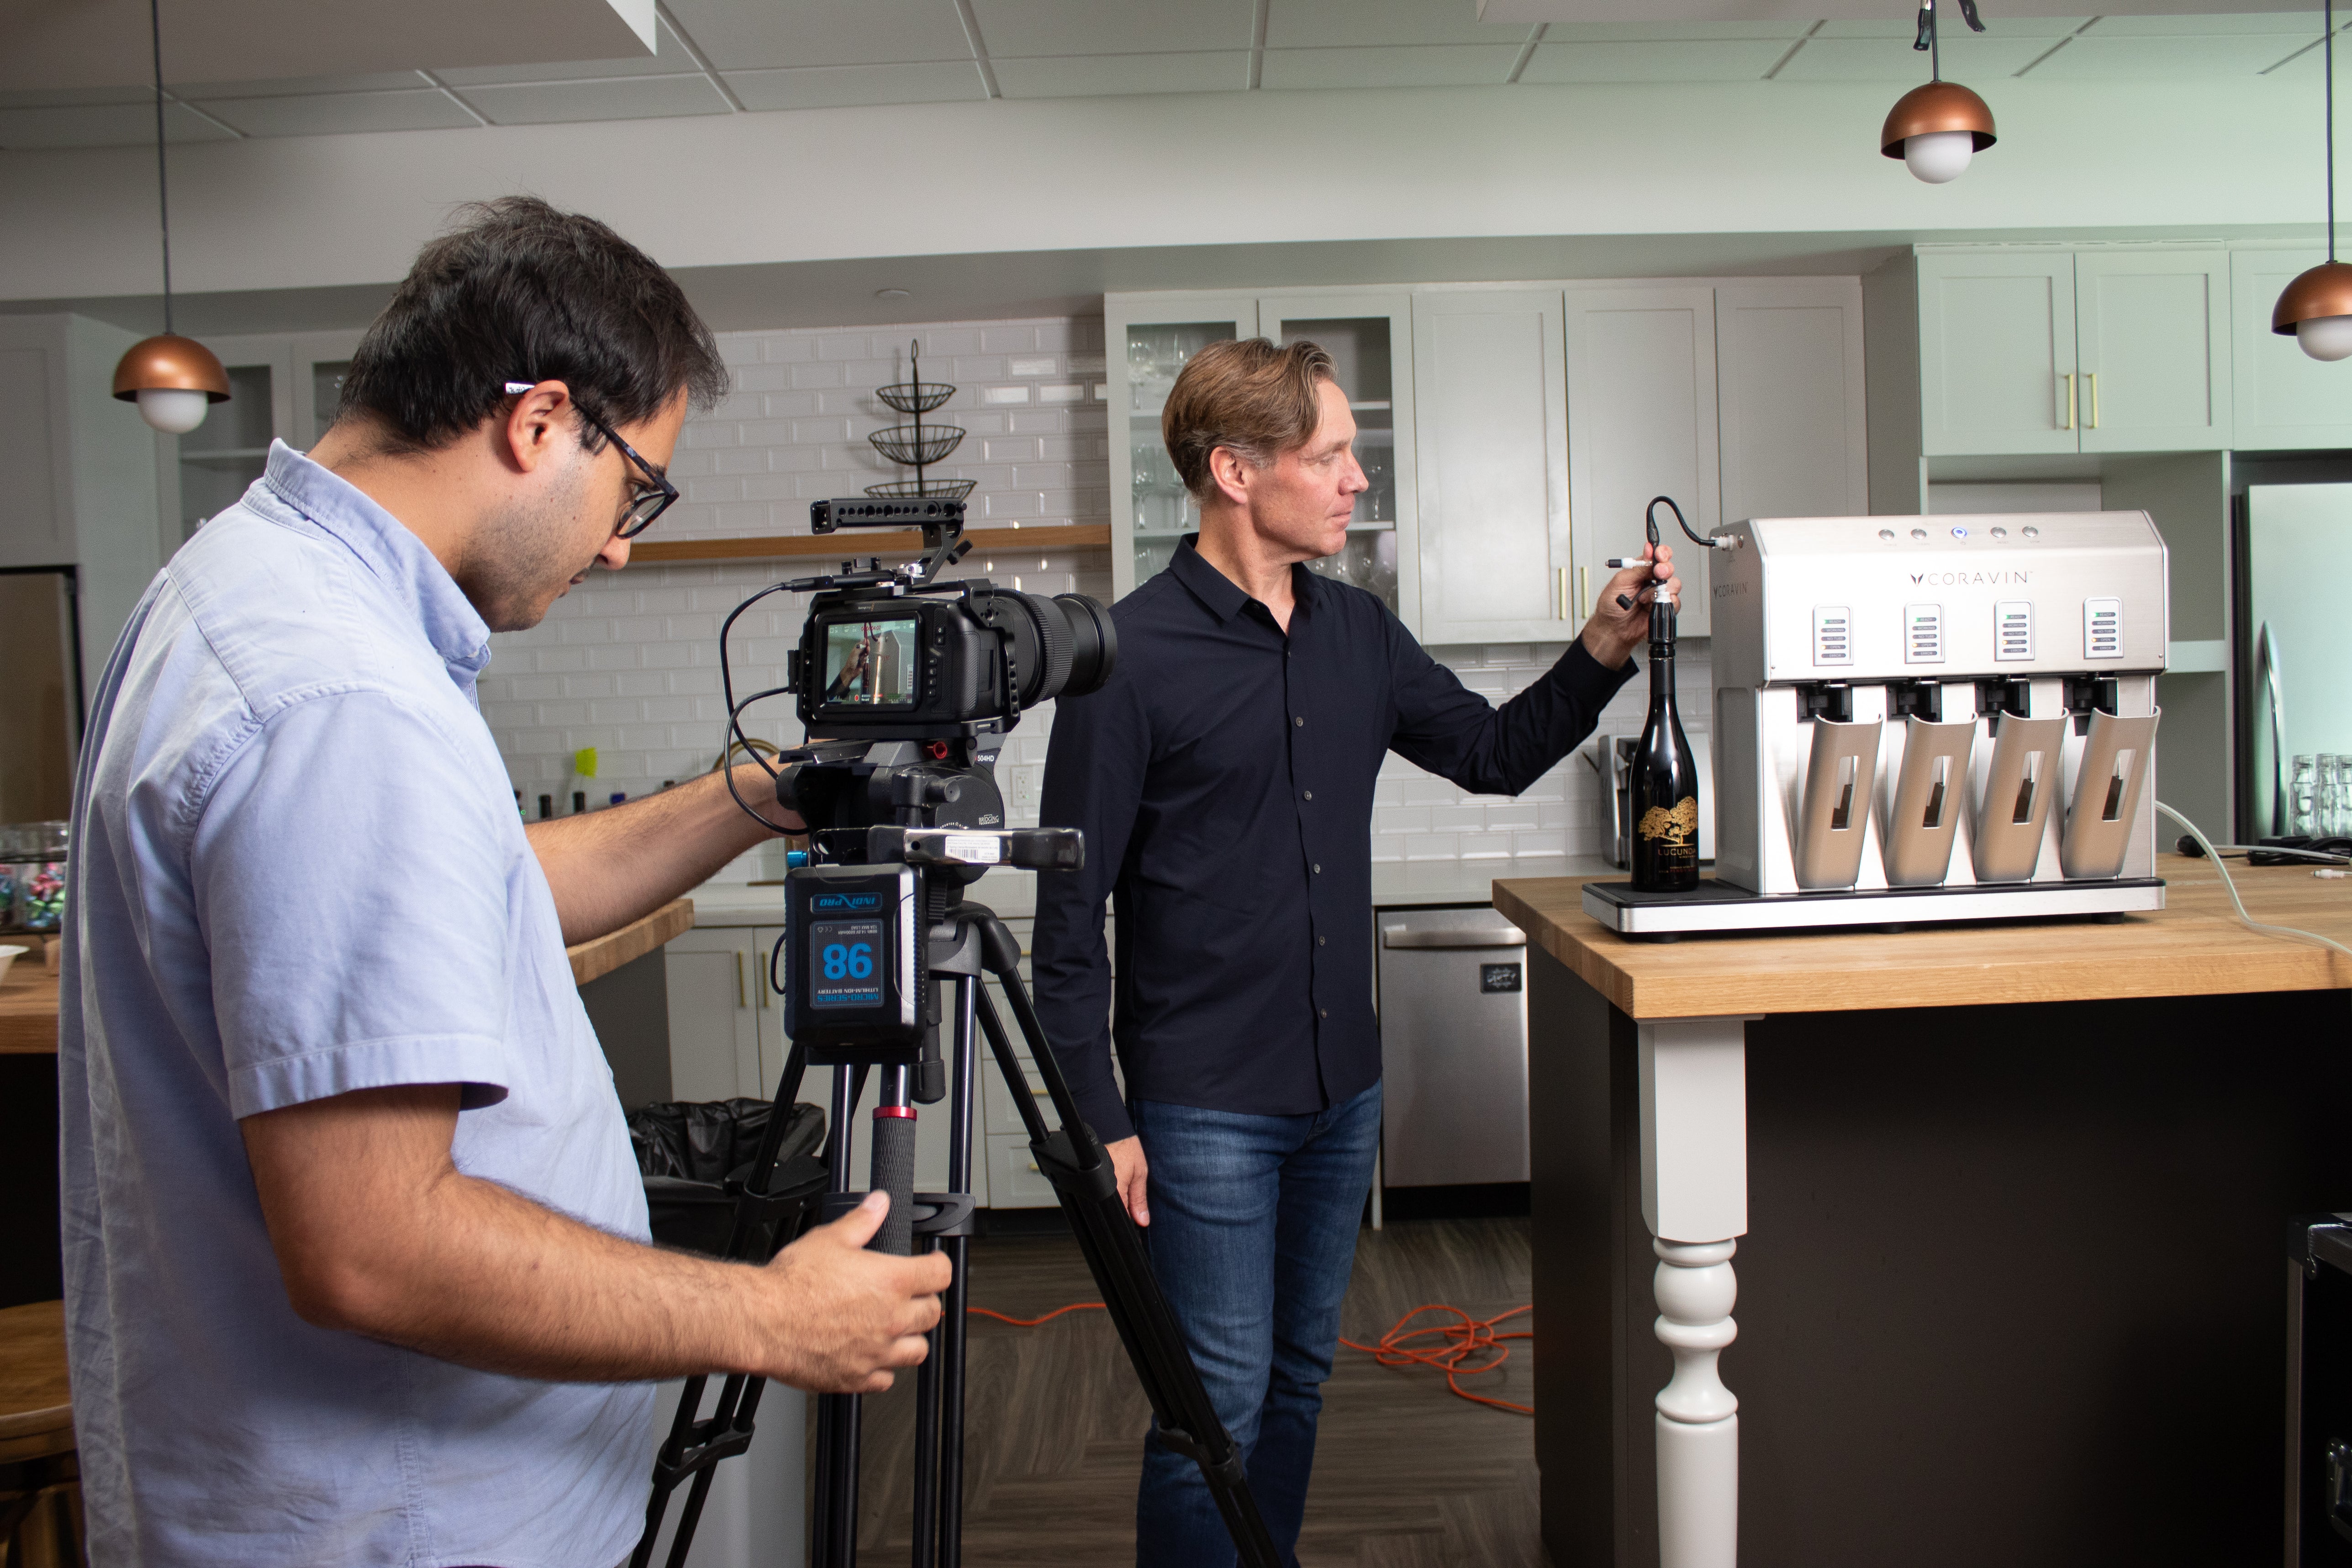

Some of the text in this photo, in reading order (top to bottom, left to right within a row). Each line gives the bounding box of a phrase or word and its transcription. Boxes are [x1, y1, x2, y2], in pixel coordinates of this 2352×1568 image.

[1928, 571, 2027, 585] CORAVIN
[979, 814, 999, 823] BRIDGING
[819, 898, 843, 907] PRO
[817, 993, 879, 1002] MICRO-SERIES
